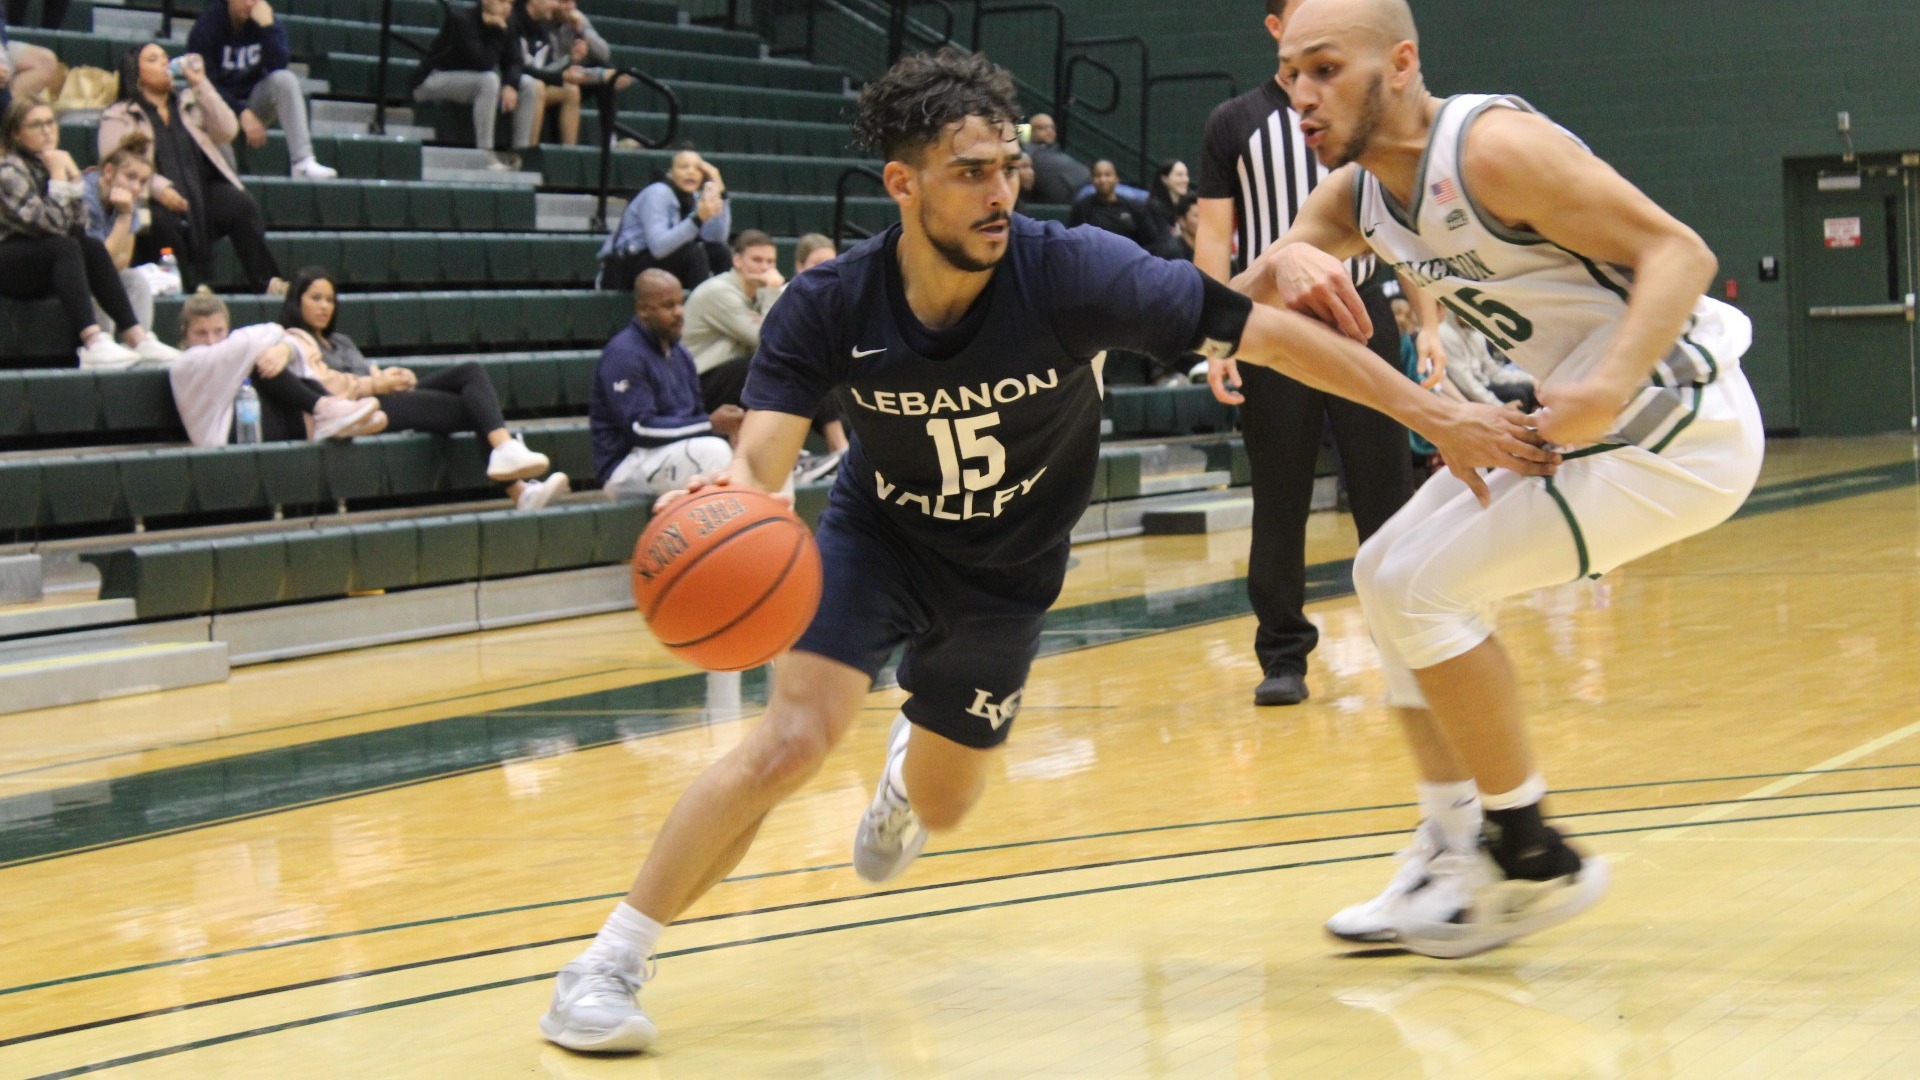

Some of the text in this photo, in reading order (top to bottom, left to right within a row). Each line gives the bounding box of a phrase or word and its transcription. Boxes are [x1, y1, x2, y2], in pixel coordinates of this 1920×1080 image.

[1438, 286, 1533, 351] 15
[851, 368, 1058, 416] LEBANON
[926, 411, 1005, 496] 15
[875, 466, 1047, 520] VALLEY
